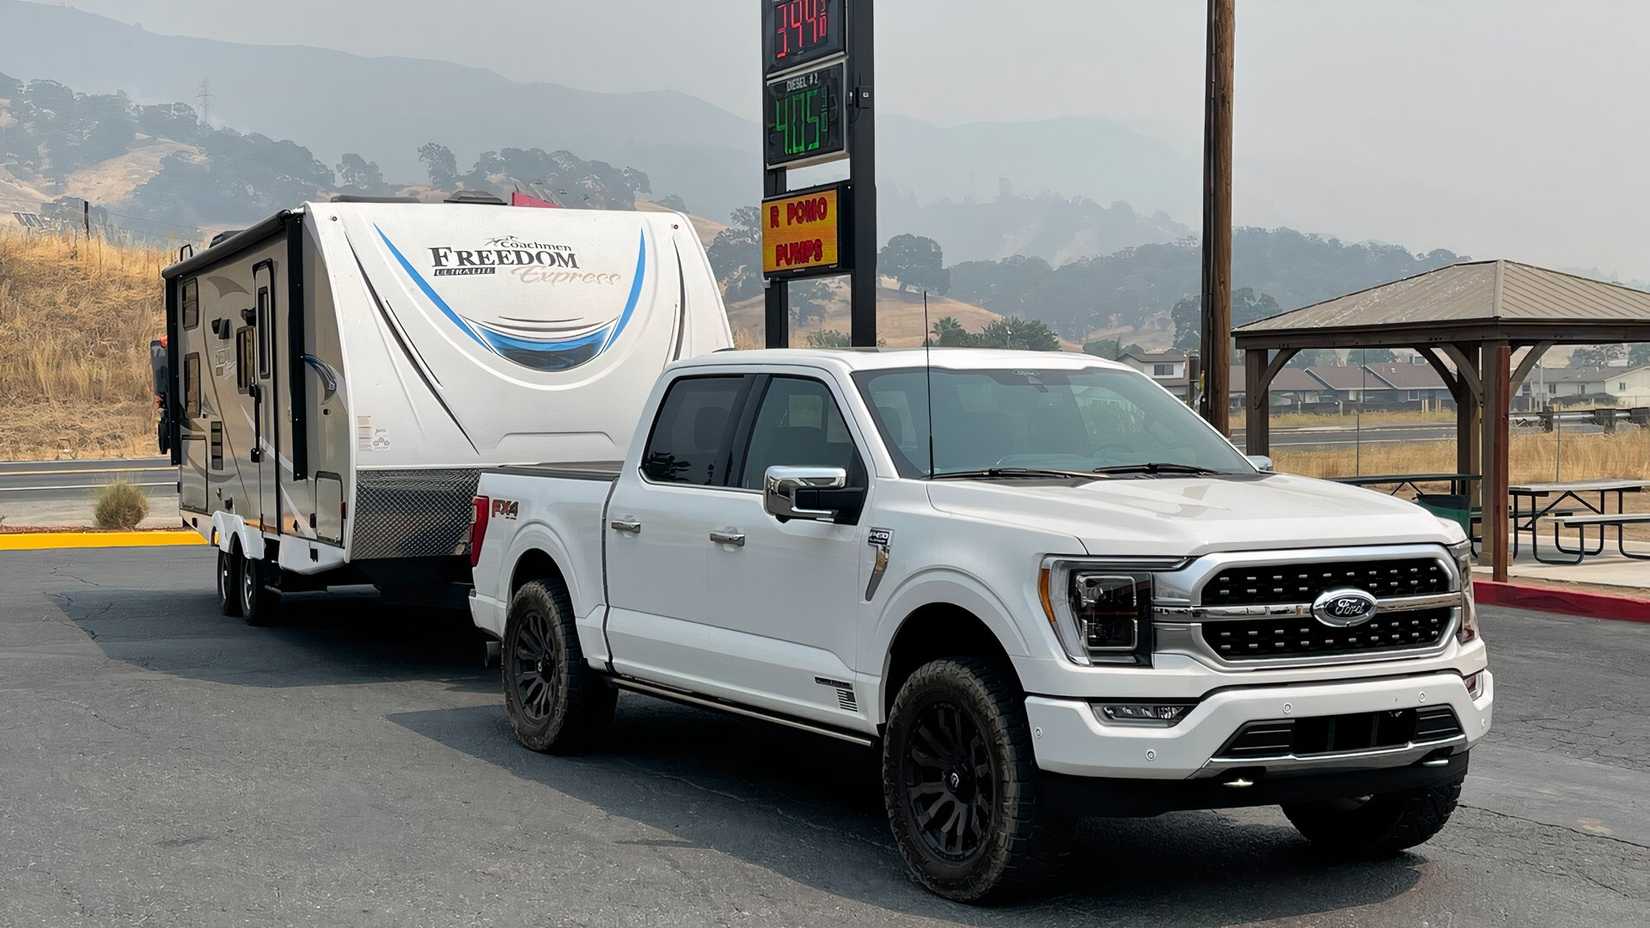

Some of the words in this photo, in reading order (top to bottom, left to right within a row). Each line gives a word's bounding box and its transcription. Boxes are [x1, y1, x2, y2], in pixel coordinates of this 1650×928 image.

[786, 76, 807, 92] DIESEL
[769, 205, 780, 229] R
[787, 197, 828, 226] POMO
[500, 240, 573, 253] Coachmen
[775, 239, 823, 267] PUMPS
[427, 246, 581, 270] FREEDOM
[511, 265, 622, 286] Express
[492, 499, 519, 518] FX4
[1335, 597, 1366, 616] Ford
